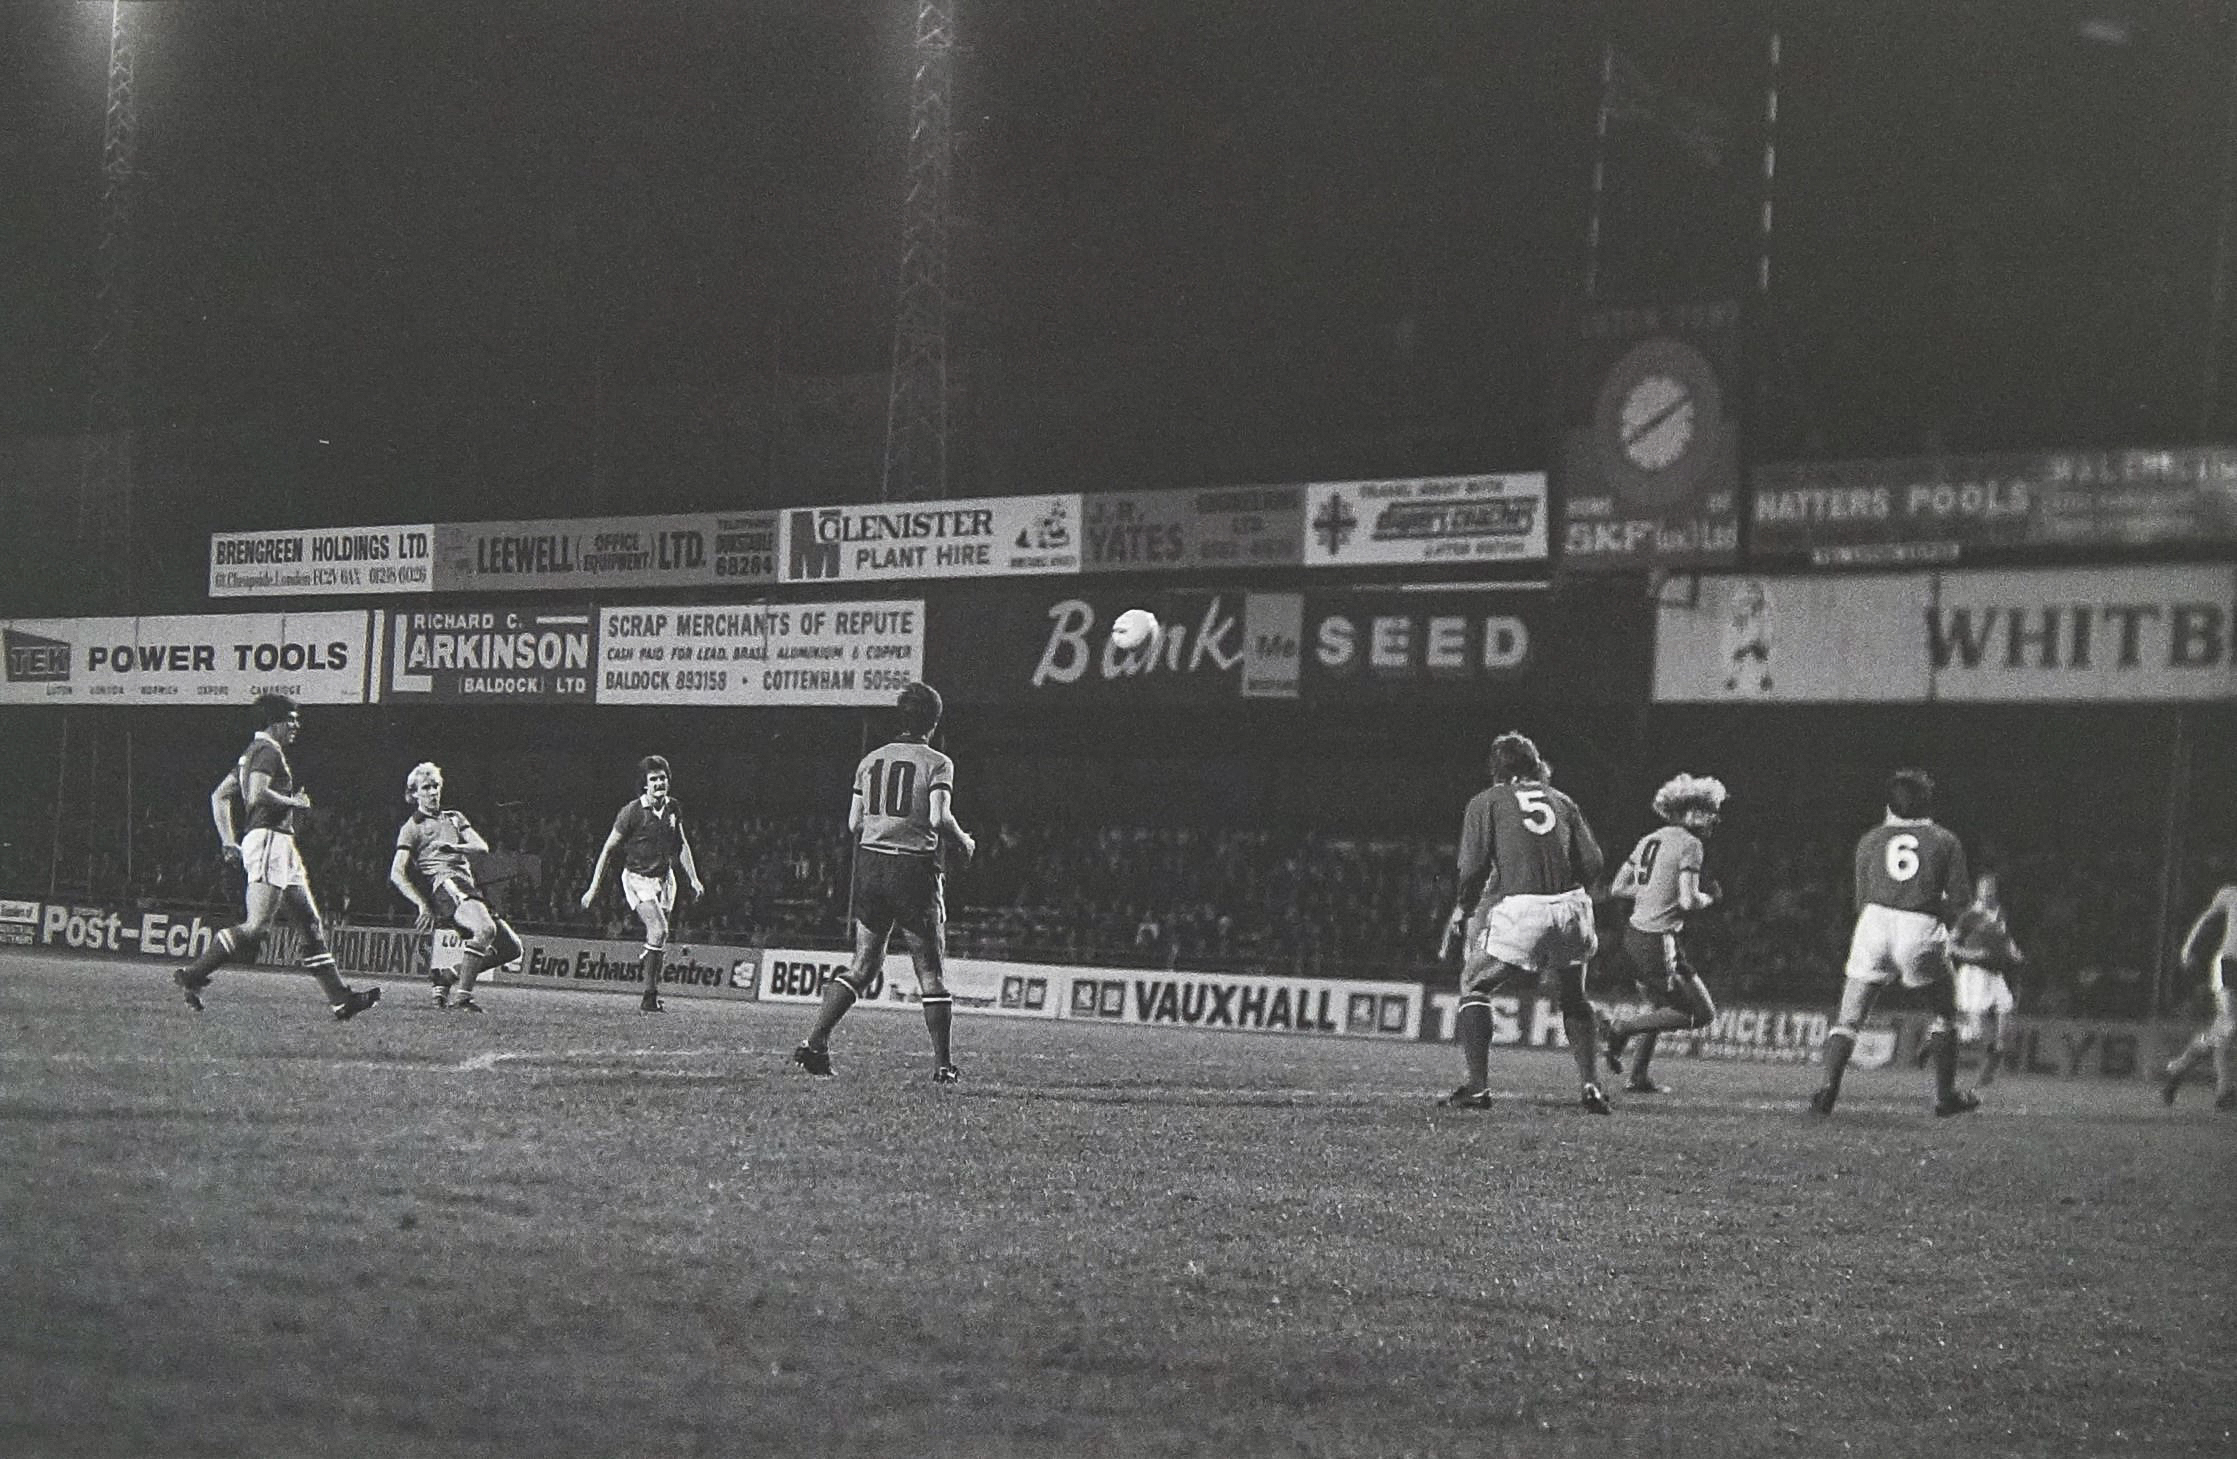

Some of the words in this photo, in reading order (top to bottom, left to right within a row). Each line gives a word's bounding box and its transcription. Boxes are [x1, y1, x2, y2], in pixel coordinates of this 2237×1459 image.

[1908, 480, 2028, 515] POOLS
[818, 509, 993, 542] GLENISTER
[216, 538, 303, 565] BRENGREEN
[311, 535, 389, 562] HOLDINGS
[477, 534, 573, 574] LEEWELL
[856, 547, 926, 569] PLANT
[936, 544, 991, 565] HIRE
[413, 613, 494, 630] RICHARD
[608, 614, 668, 637] SCRAP
[676, 612, 790, 637] MERCHANTS
[801, 611, 826, 635] OF
[835, 611, 914, 635] REPUTE
[1924, 602, 2237, 670] WHITB
[88, 643, 215, 673] POWER
[234, 641, 348, 671] TOOLS
[1316, 614, 1529, 669] SEED
[556, 676, 586, 694] LTD
[605, 671, 669, 691] BALDOCK
[763, 670, 855, 690] COTTENHAM
[868, 758, 917, 817] 10
[1515, 789, 1556, 835] 5
[1637, 839, 1662, 885] 9
[1886, 833, 1920, 881] 6
[43, 904, 213, 957] Post-Ech
[529, 948, 569, 977] Euro
[573, 951, 645, 983] Exhaust
[656, 962, 724, 987] entres
[1135, 979, 1337, 1030] VAUXHALL
